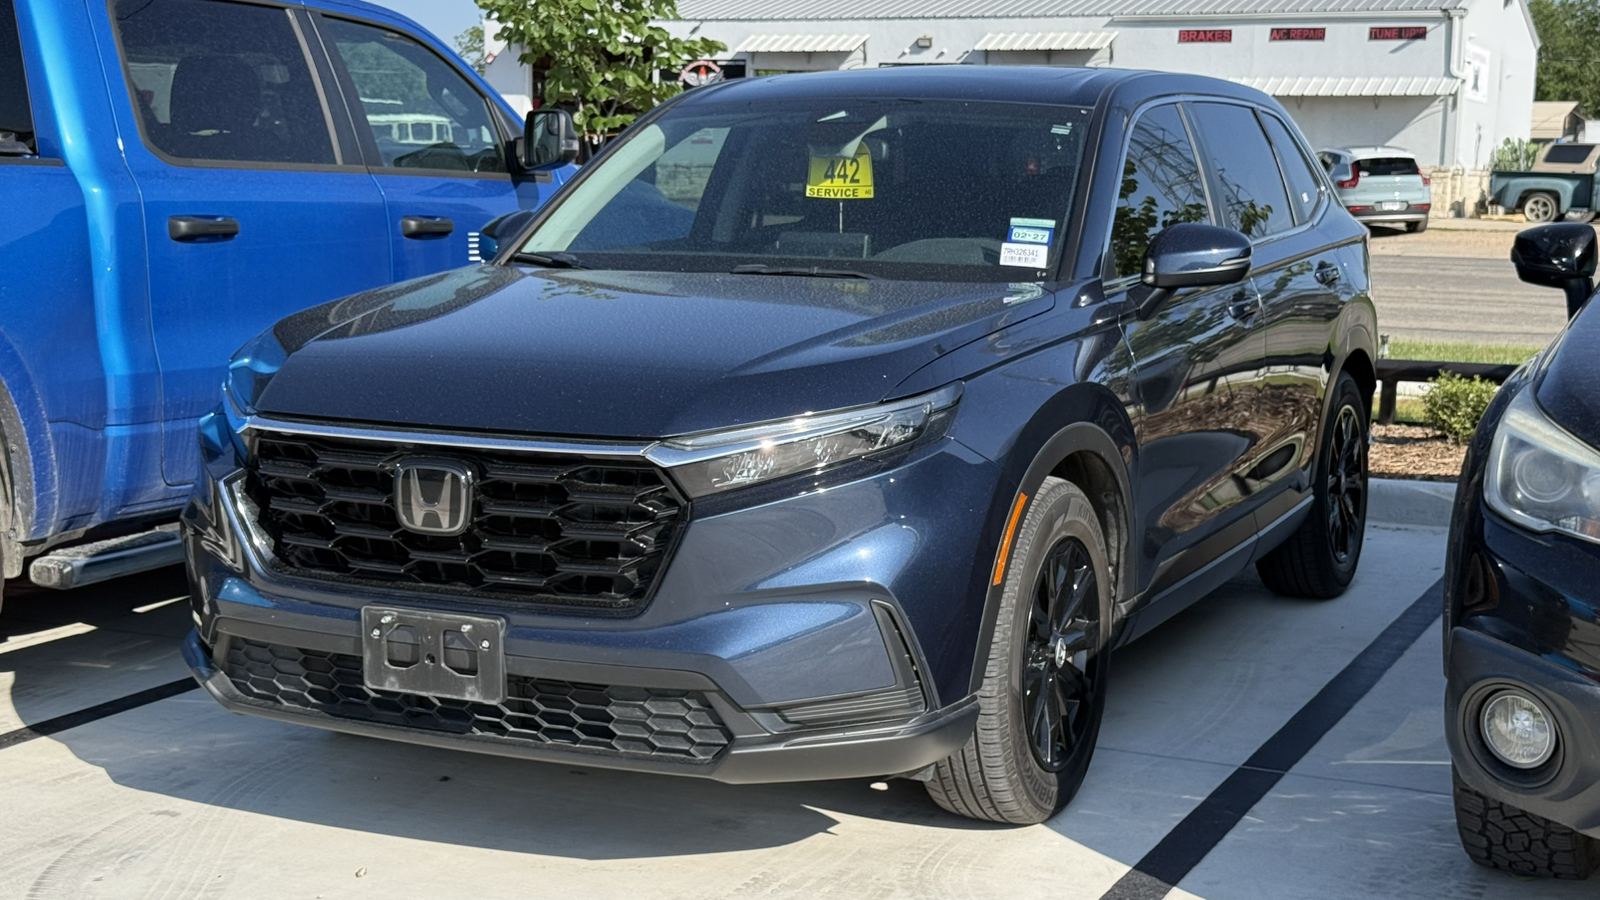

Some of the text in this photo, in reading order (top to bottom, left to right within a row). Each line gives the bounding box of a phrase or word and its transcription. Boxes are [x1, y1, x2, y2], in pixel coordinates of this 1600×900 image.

[1180, 31, 1231, 41] BRAKES
[1271, 29, 1324, 40] A/C REPAIR
[1371, 28, 1398, 39] TUNE
[824, 158, 860, 184] 442
[808, 187, 859, 198] SERVICE
